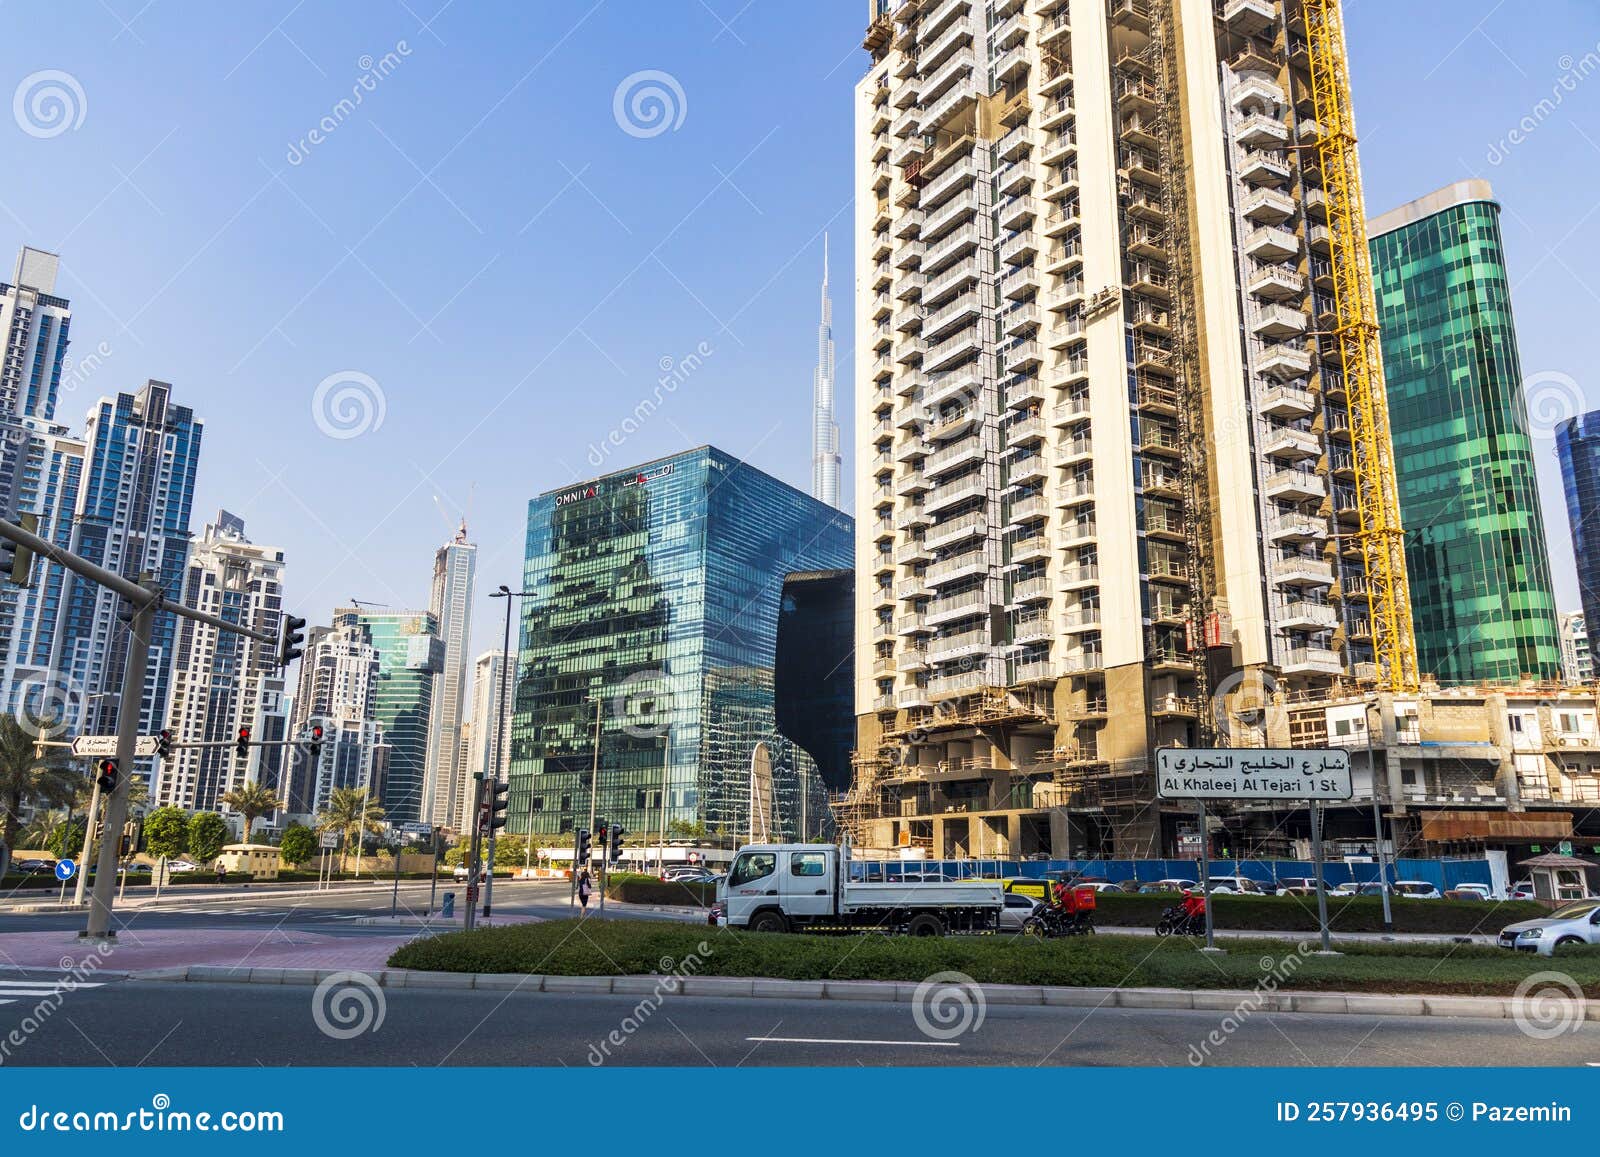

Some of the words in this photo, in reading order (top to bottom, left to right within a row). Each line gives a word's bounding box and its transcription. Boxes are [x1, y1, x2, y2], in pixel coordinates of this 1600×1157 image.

[555, 484, 601, 506] OMNIYAT
[1174, 755, 1233, 774] التجاري
[1240, 756, 1294, 775] الخليج
[1302, 756, 1345, 776] شارع
[1163, 778, 1179, 791] Al
[1183, 778, 1237, 792] Khaleej
[1243, 779, 1258, 791] Al
[1309, 780, 1315, 791] 1
[1320, 780, 1337, 792] St
